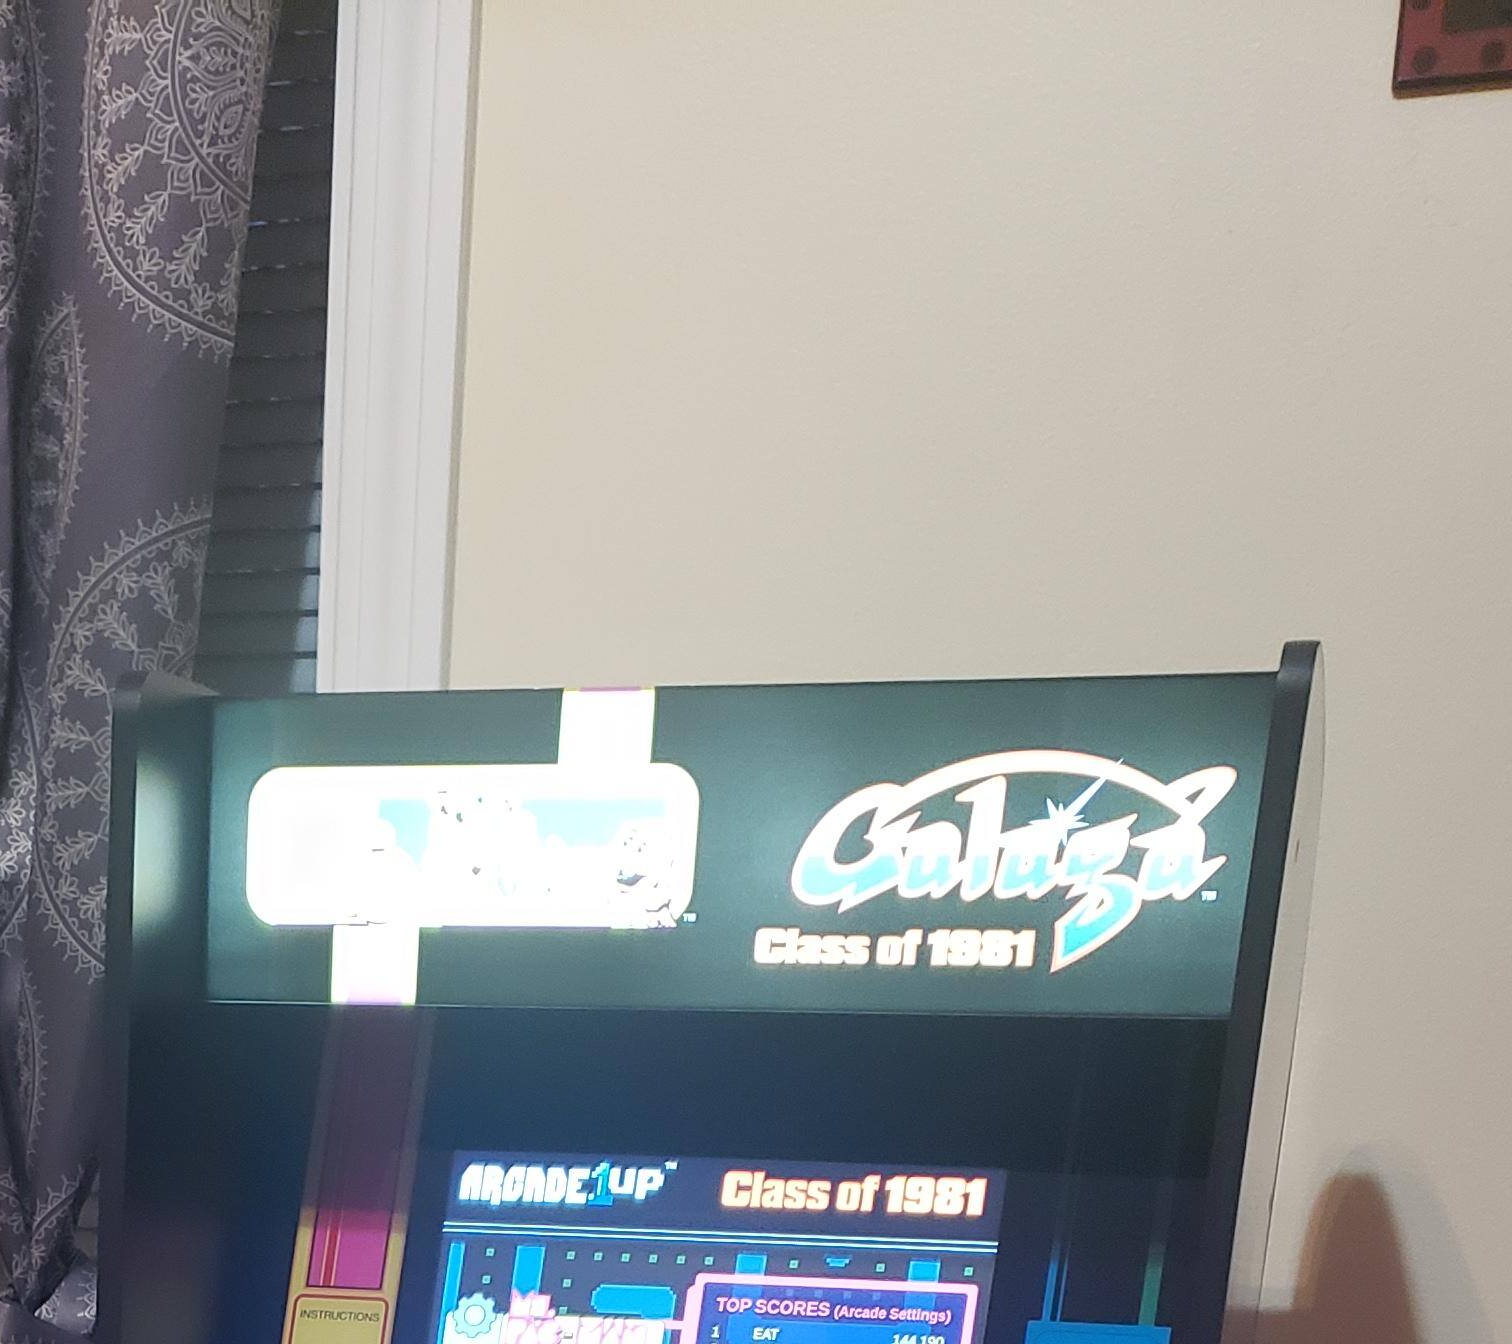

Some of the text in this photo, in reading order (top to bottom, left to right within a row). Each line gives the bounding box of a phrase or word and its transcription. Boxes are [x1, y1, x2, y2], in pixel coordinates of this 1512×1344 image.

[753, 927, 870, 966] Class
[875, 928, 923, 966] of
[721, 1170, 988, 1216] Class of 1981
[300, 1309, 380, 1323] INSTRUCTIONS
[716, 1297, 952, 1325] TOP SCORES (Arcade Settings)
[711, 1326, 719, 1338] 1
[753, 1327, 779, 1340] EAT
